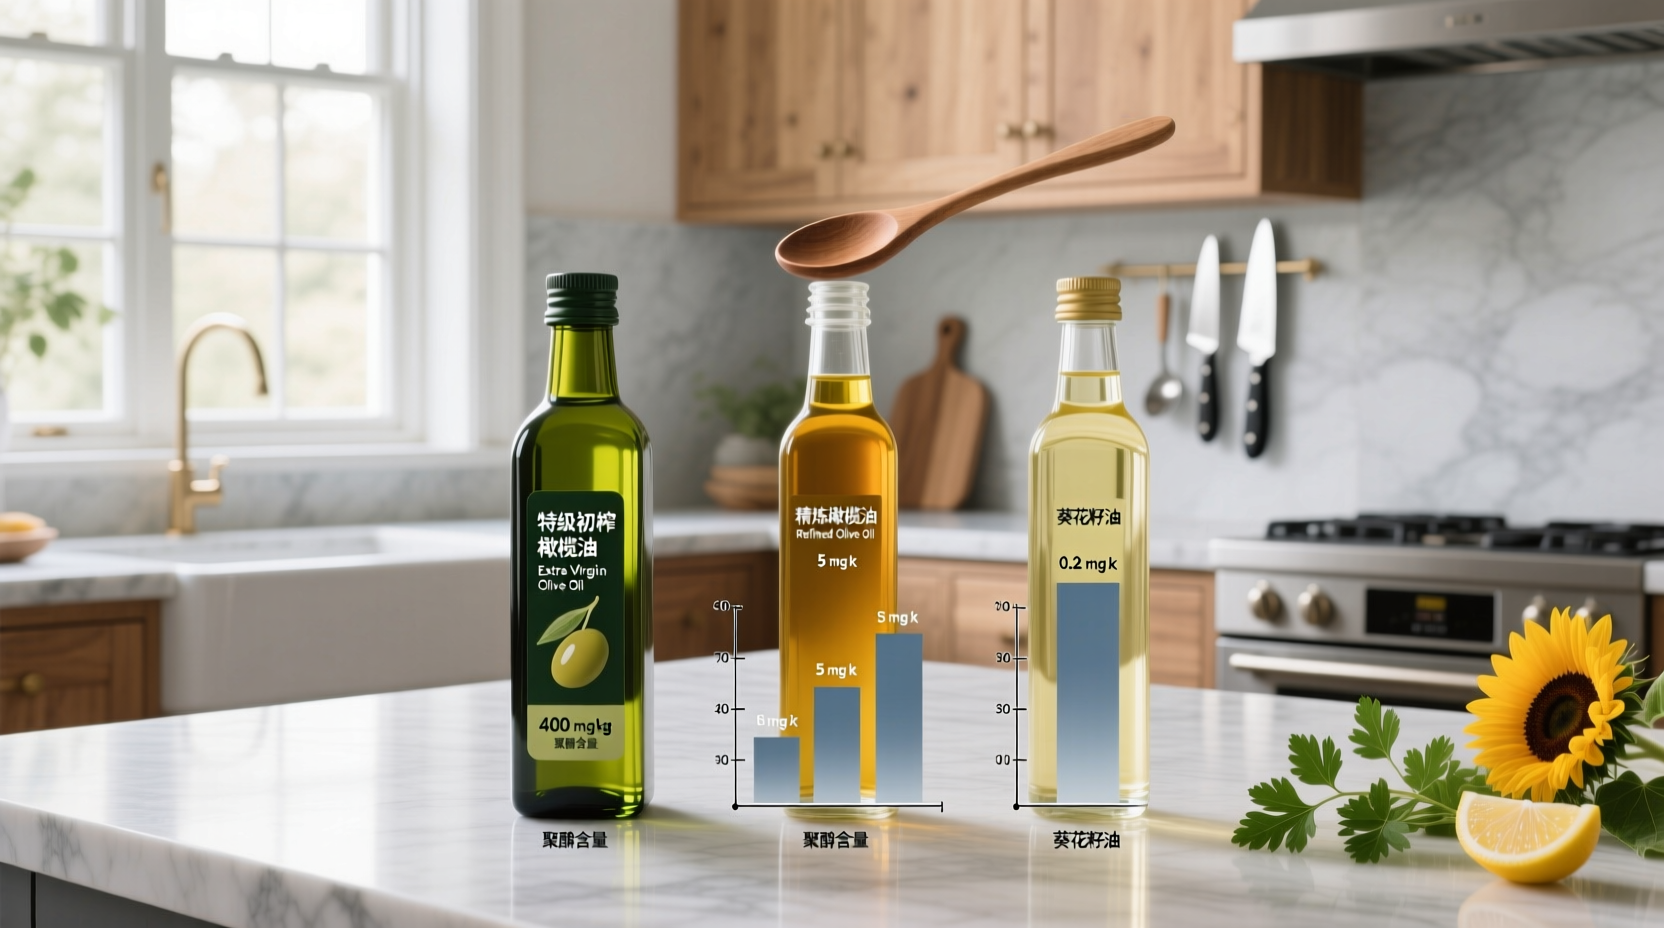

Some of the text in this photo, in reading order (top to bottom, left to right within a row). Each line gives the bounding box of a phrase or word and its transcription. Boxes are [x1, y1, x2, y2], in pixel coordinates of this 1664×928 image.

[537, 511, 616, 533] 特级初榨
[1056, 507, 1121, 526] 葵花籽油
[537, 536, 597, 558] 橄榄油
[817, 553, 826, 567] 5
[1059, 555, 1082, 570] 0.2
[538, 564, 607, 580] Extra Virgin
[538, 579, 567, 591] Olive
[539, 717, 570, 732] 400
